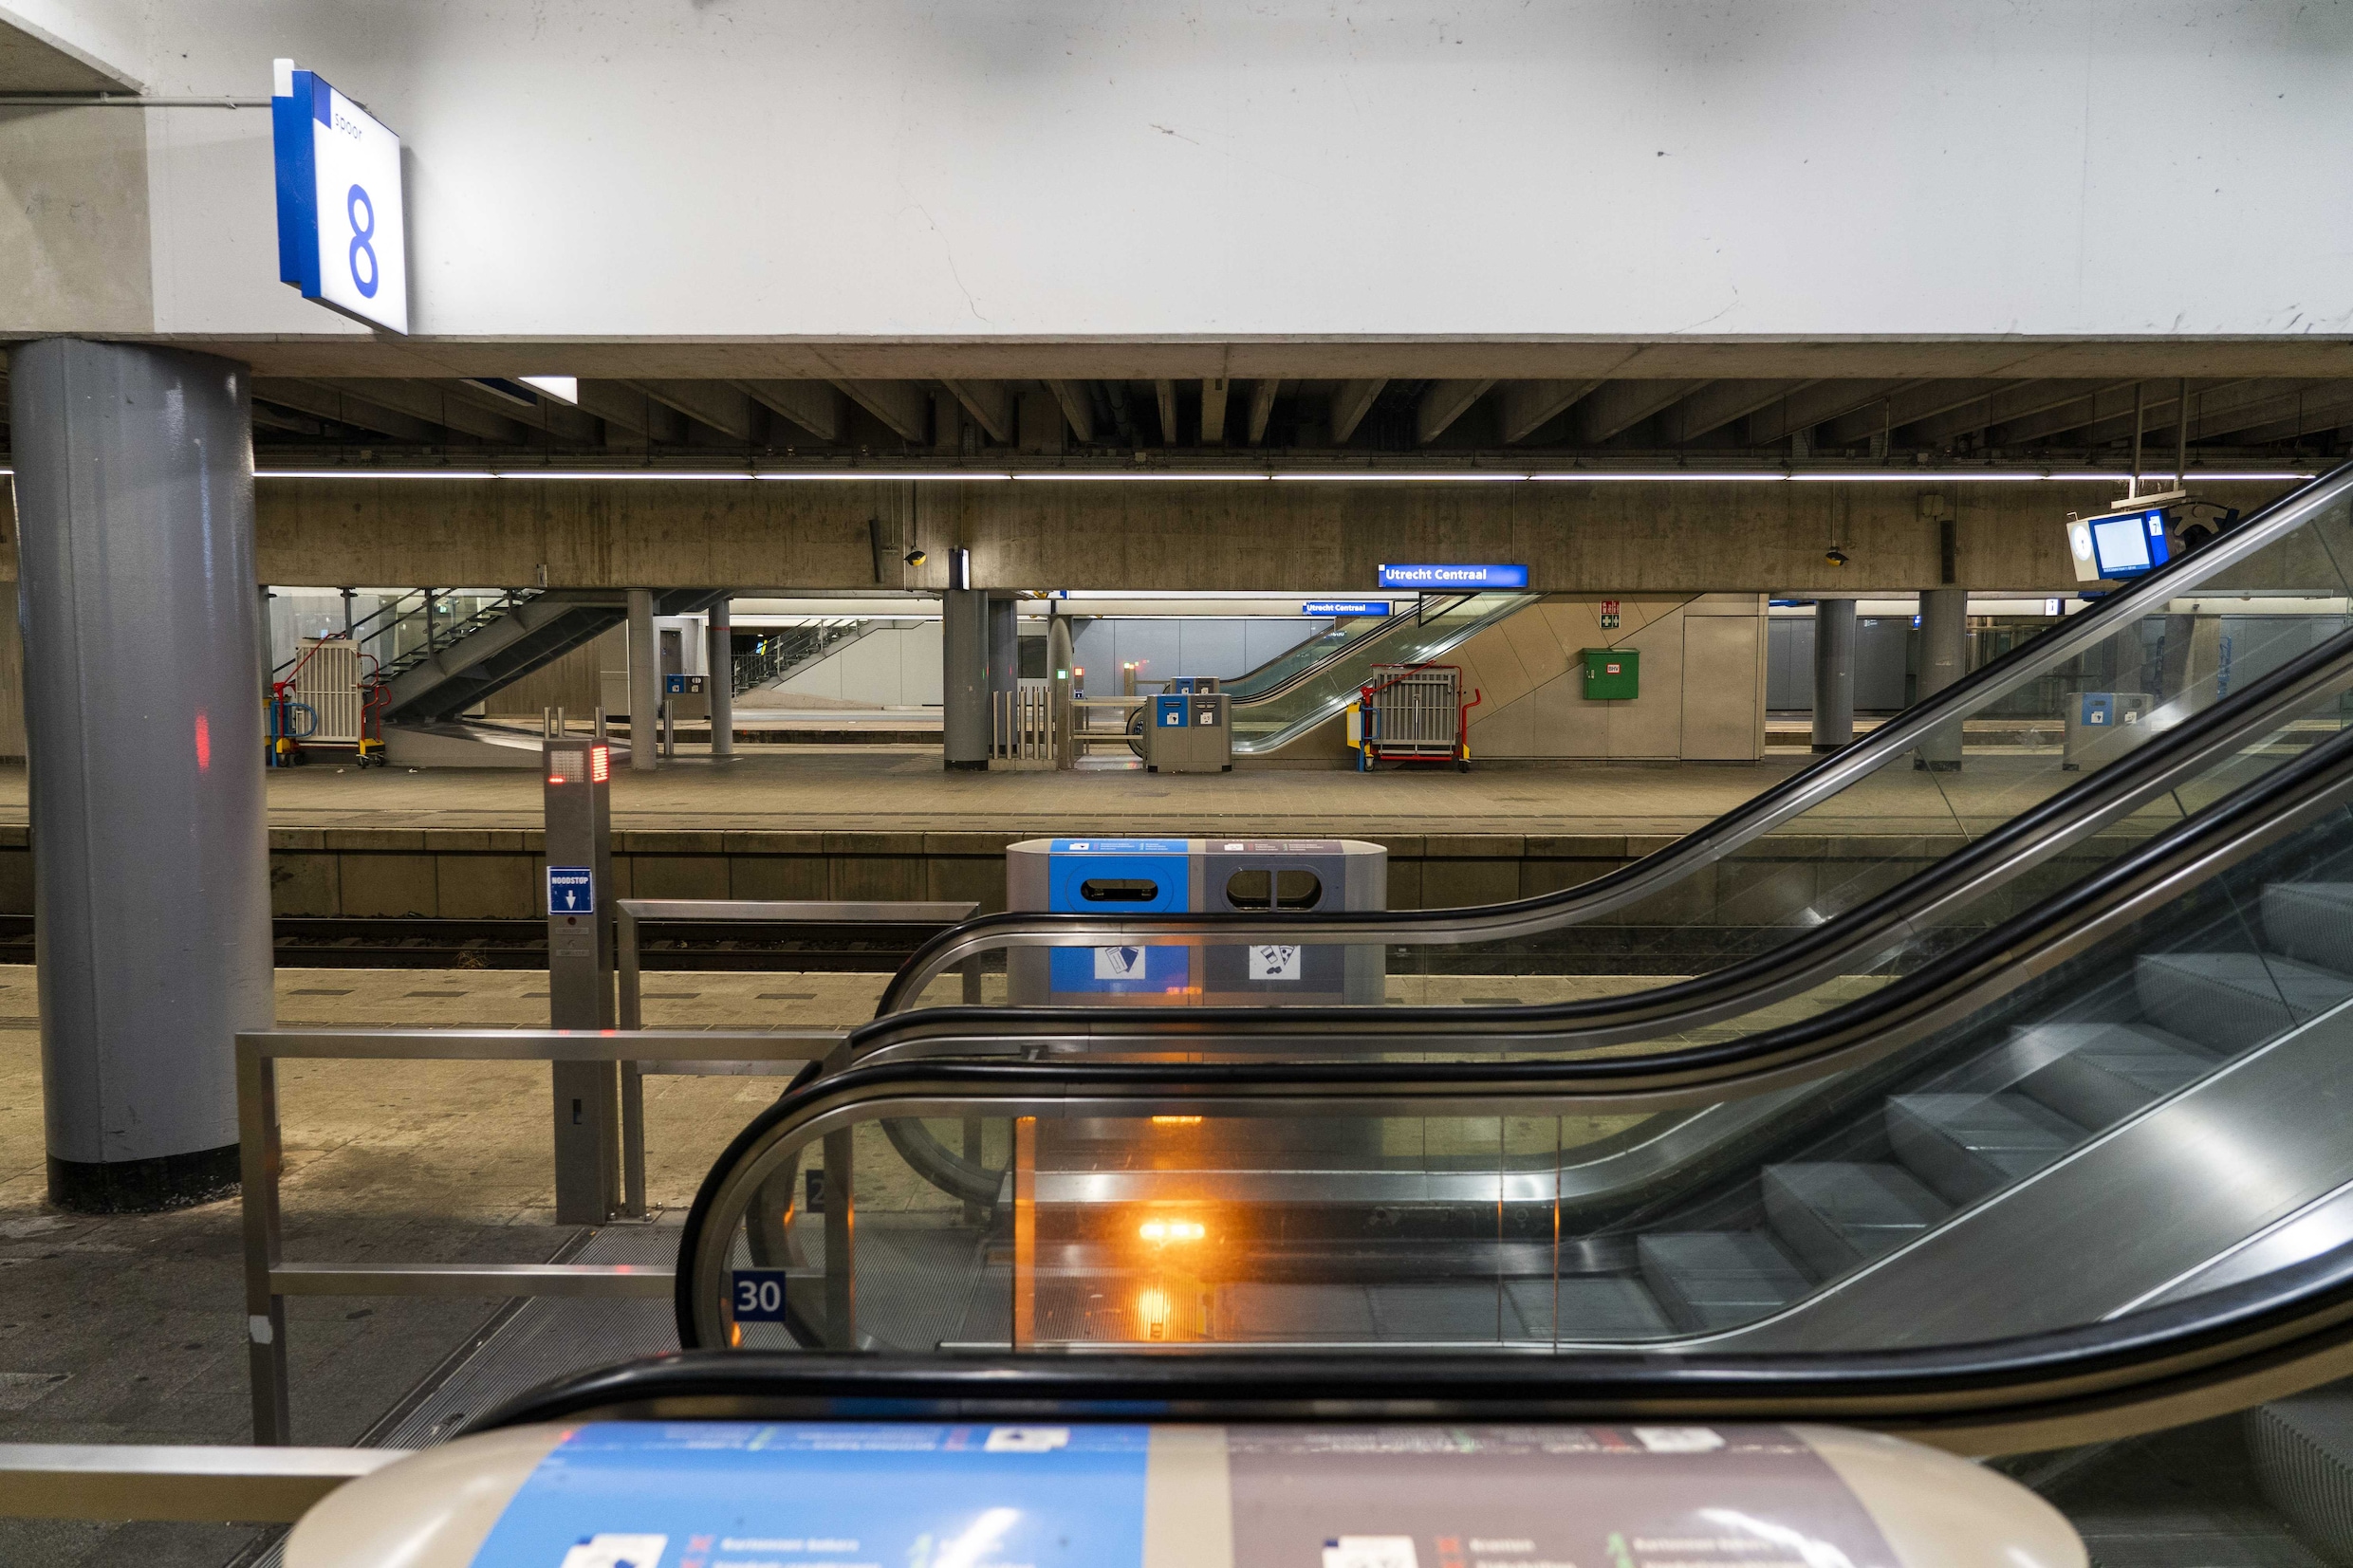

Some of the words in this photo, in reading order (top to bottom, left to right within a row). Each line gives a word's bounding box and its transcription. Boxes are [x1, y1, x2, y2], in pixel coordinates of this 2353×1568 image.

[334, 112, 362, 142] spoor
[347, 183, 379, 300] 8
[1385, 568, 1432, 581] Utrecht
[1434, 568, 1487, 581] Centraal
[1306, 603, 1331, 612] Utrecht
[1334, 603, 1366, 612] Centraal
[551, 876, 588, 885] NOODSTOP
[737, 1280, 782, 1313] 30
